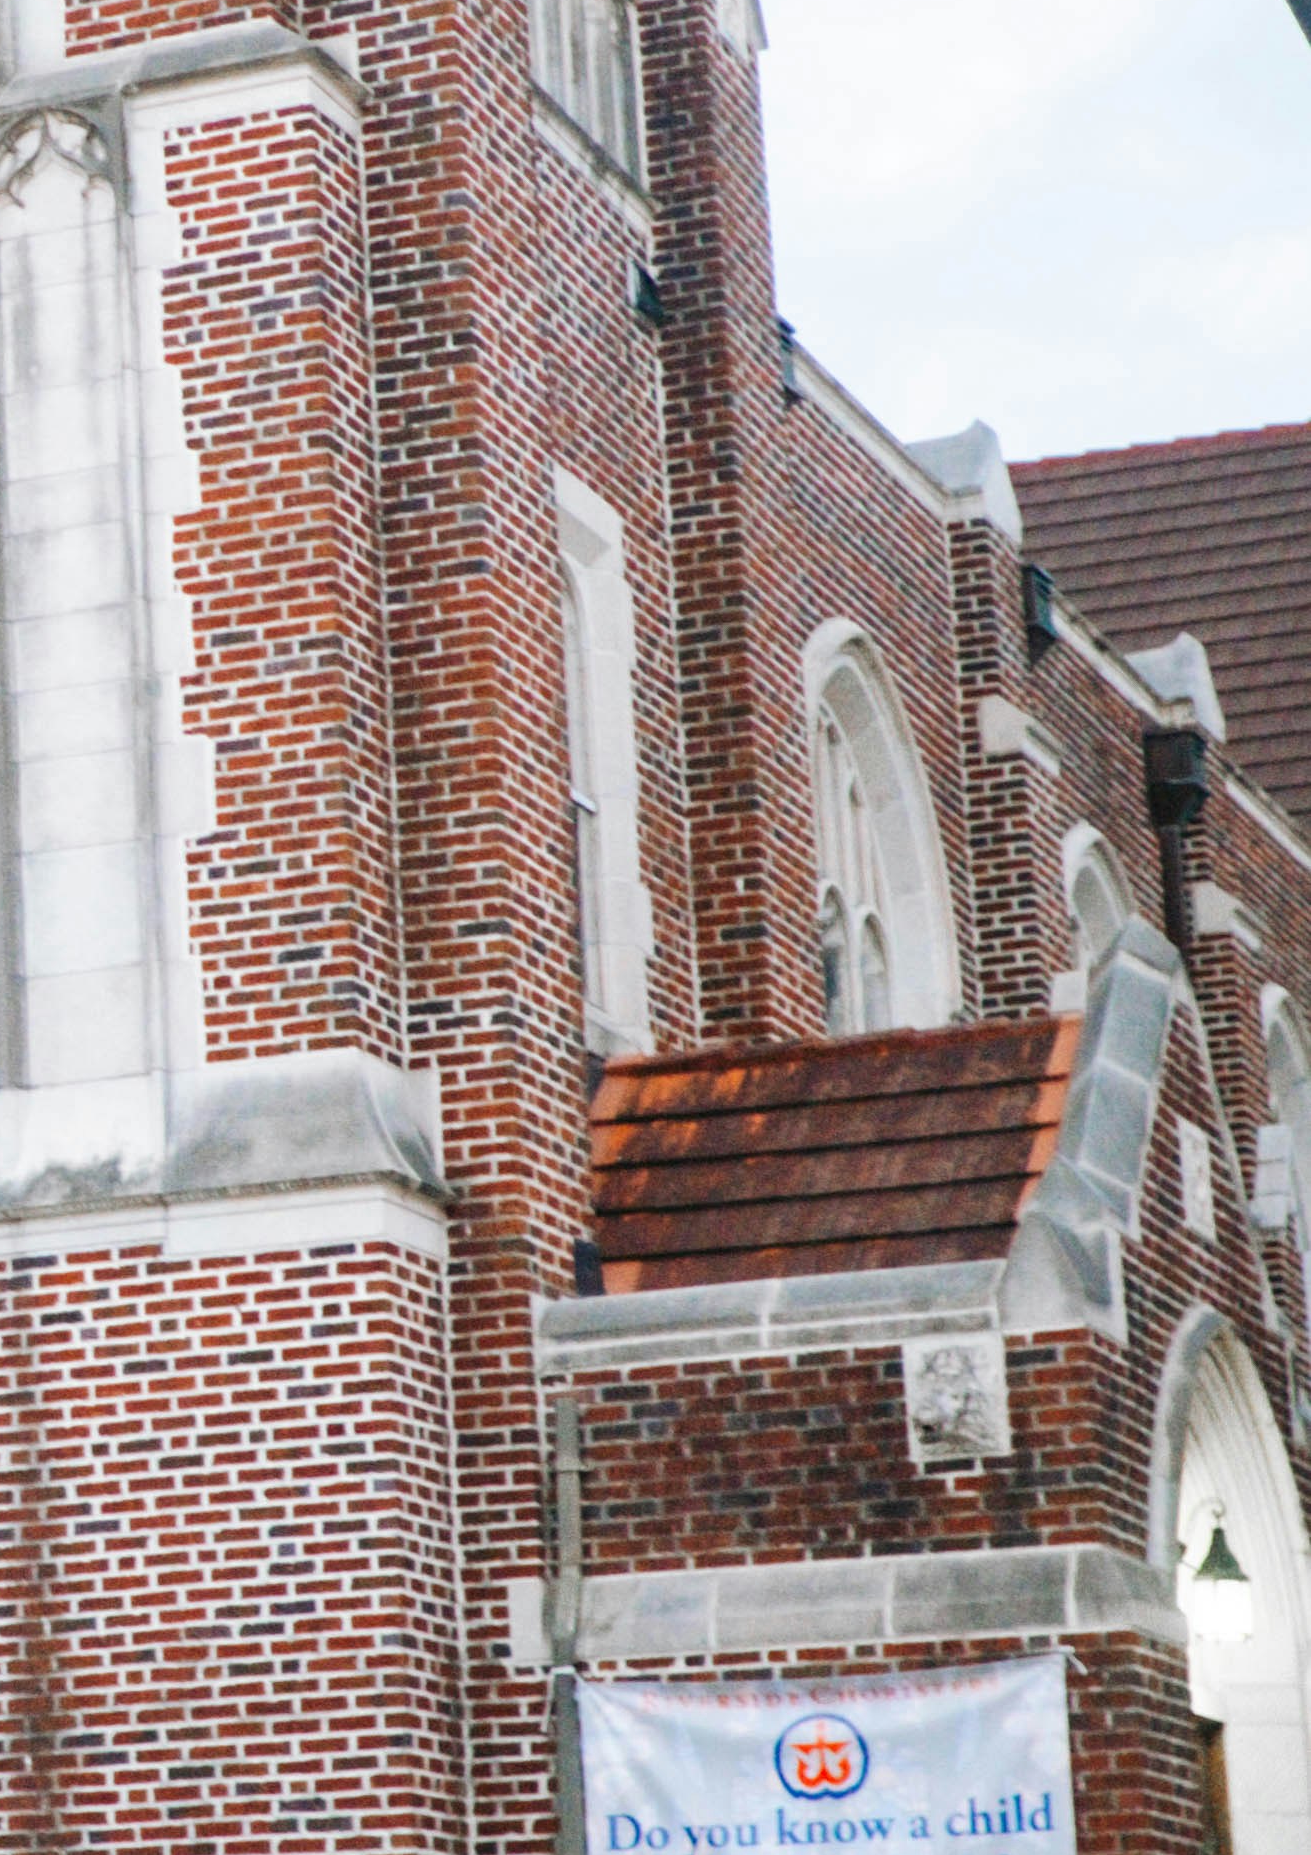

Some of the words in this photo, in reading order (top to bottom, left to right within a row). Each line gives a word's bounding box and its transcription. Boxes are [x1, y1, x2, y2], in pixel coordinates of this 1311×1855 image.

[607, 1813, 670, 1851] Do
[777, 1808, 893, 1846] know
[910, 1814, 931, 1839] a
[945, 1792, 1055, 1837] child
